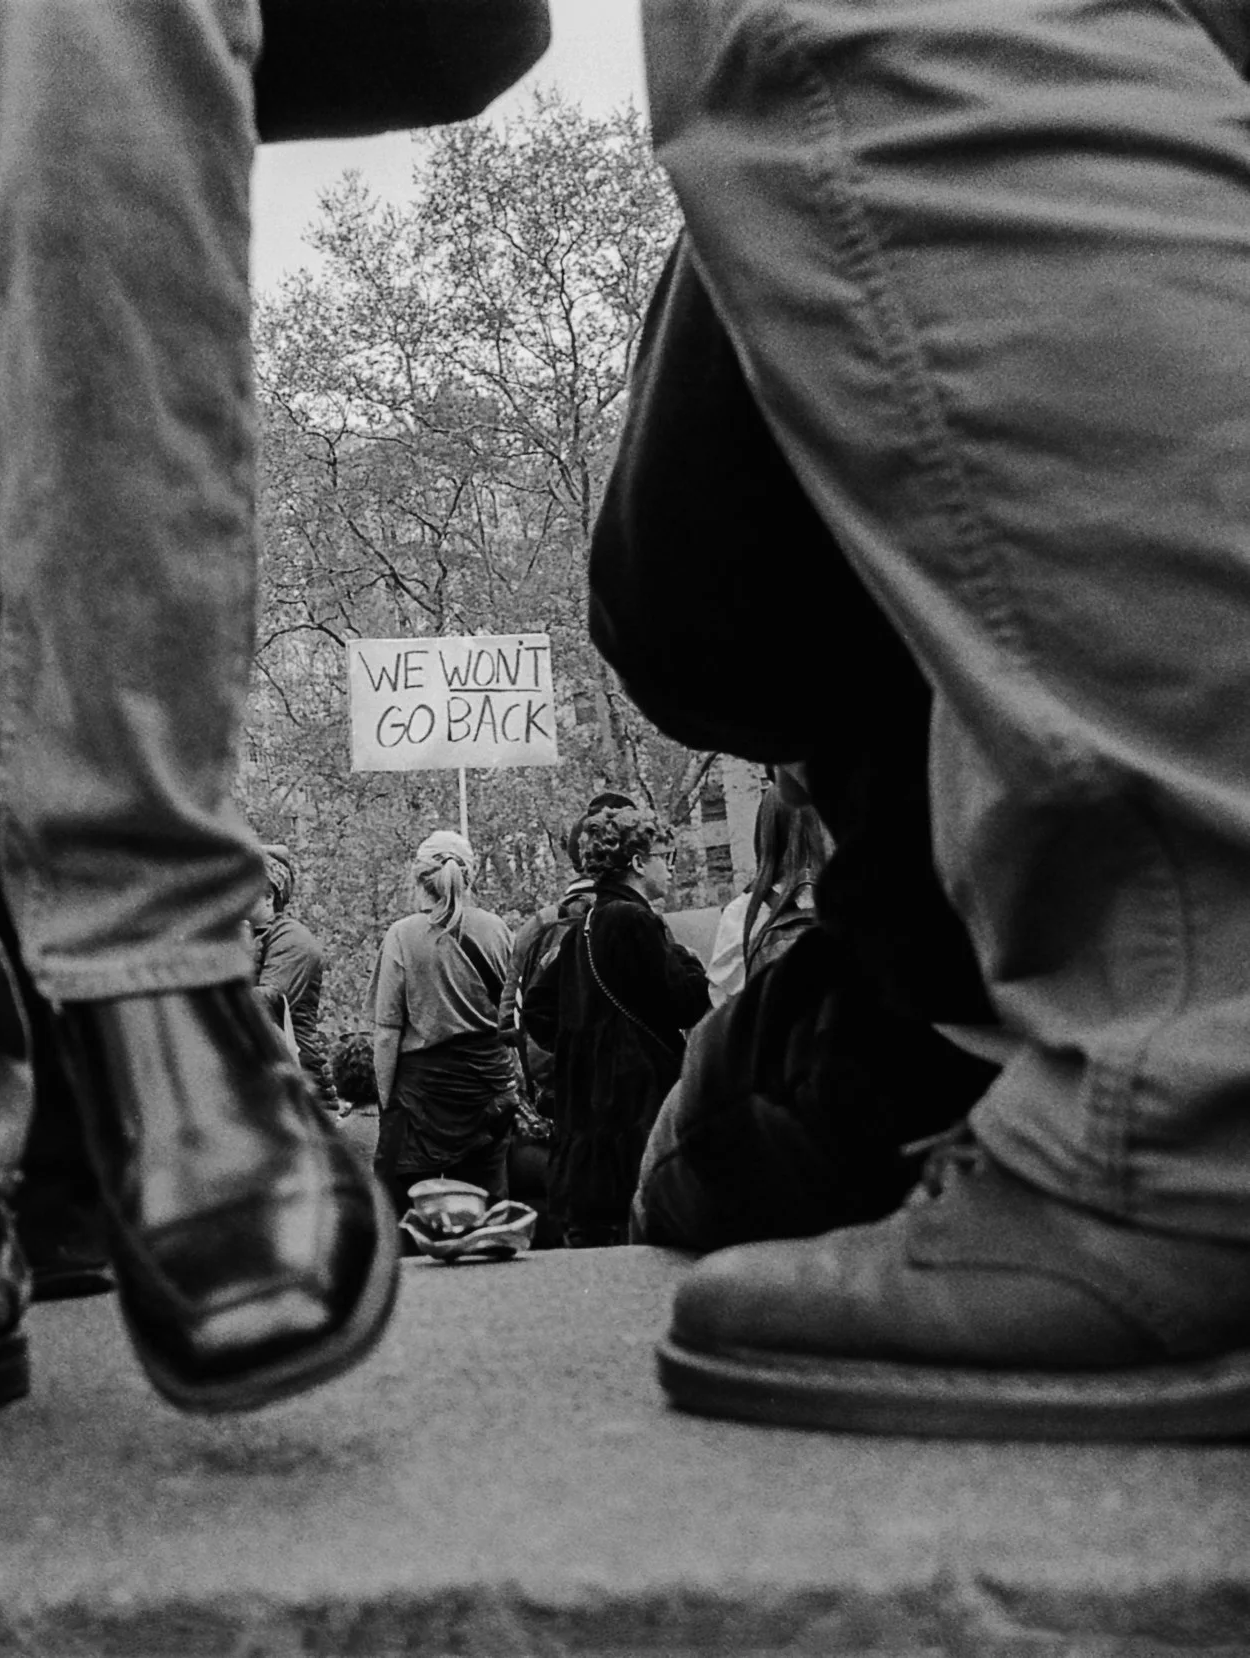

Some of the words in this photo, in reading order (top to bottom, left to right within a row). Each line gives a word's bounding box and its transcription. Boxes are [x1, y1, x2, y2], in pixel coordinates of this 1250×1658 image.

[358, 650, 429, 692] WE
[376, 703, 435, 748] GO
[447, 694, 551, 744] BACK
